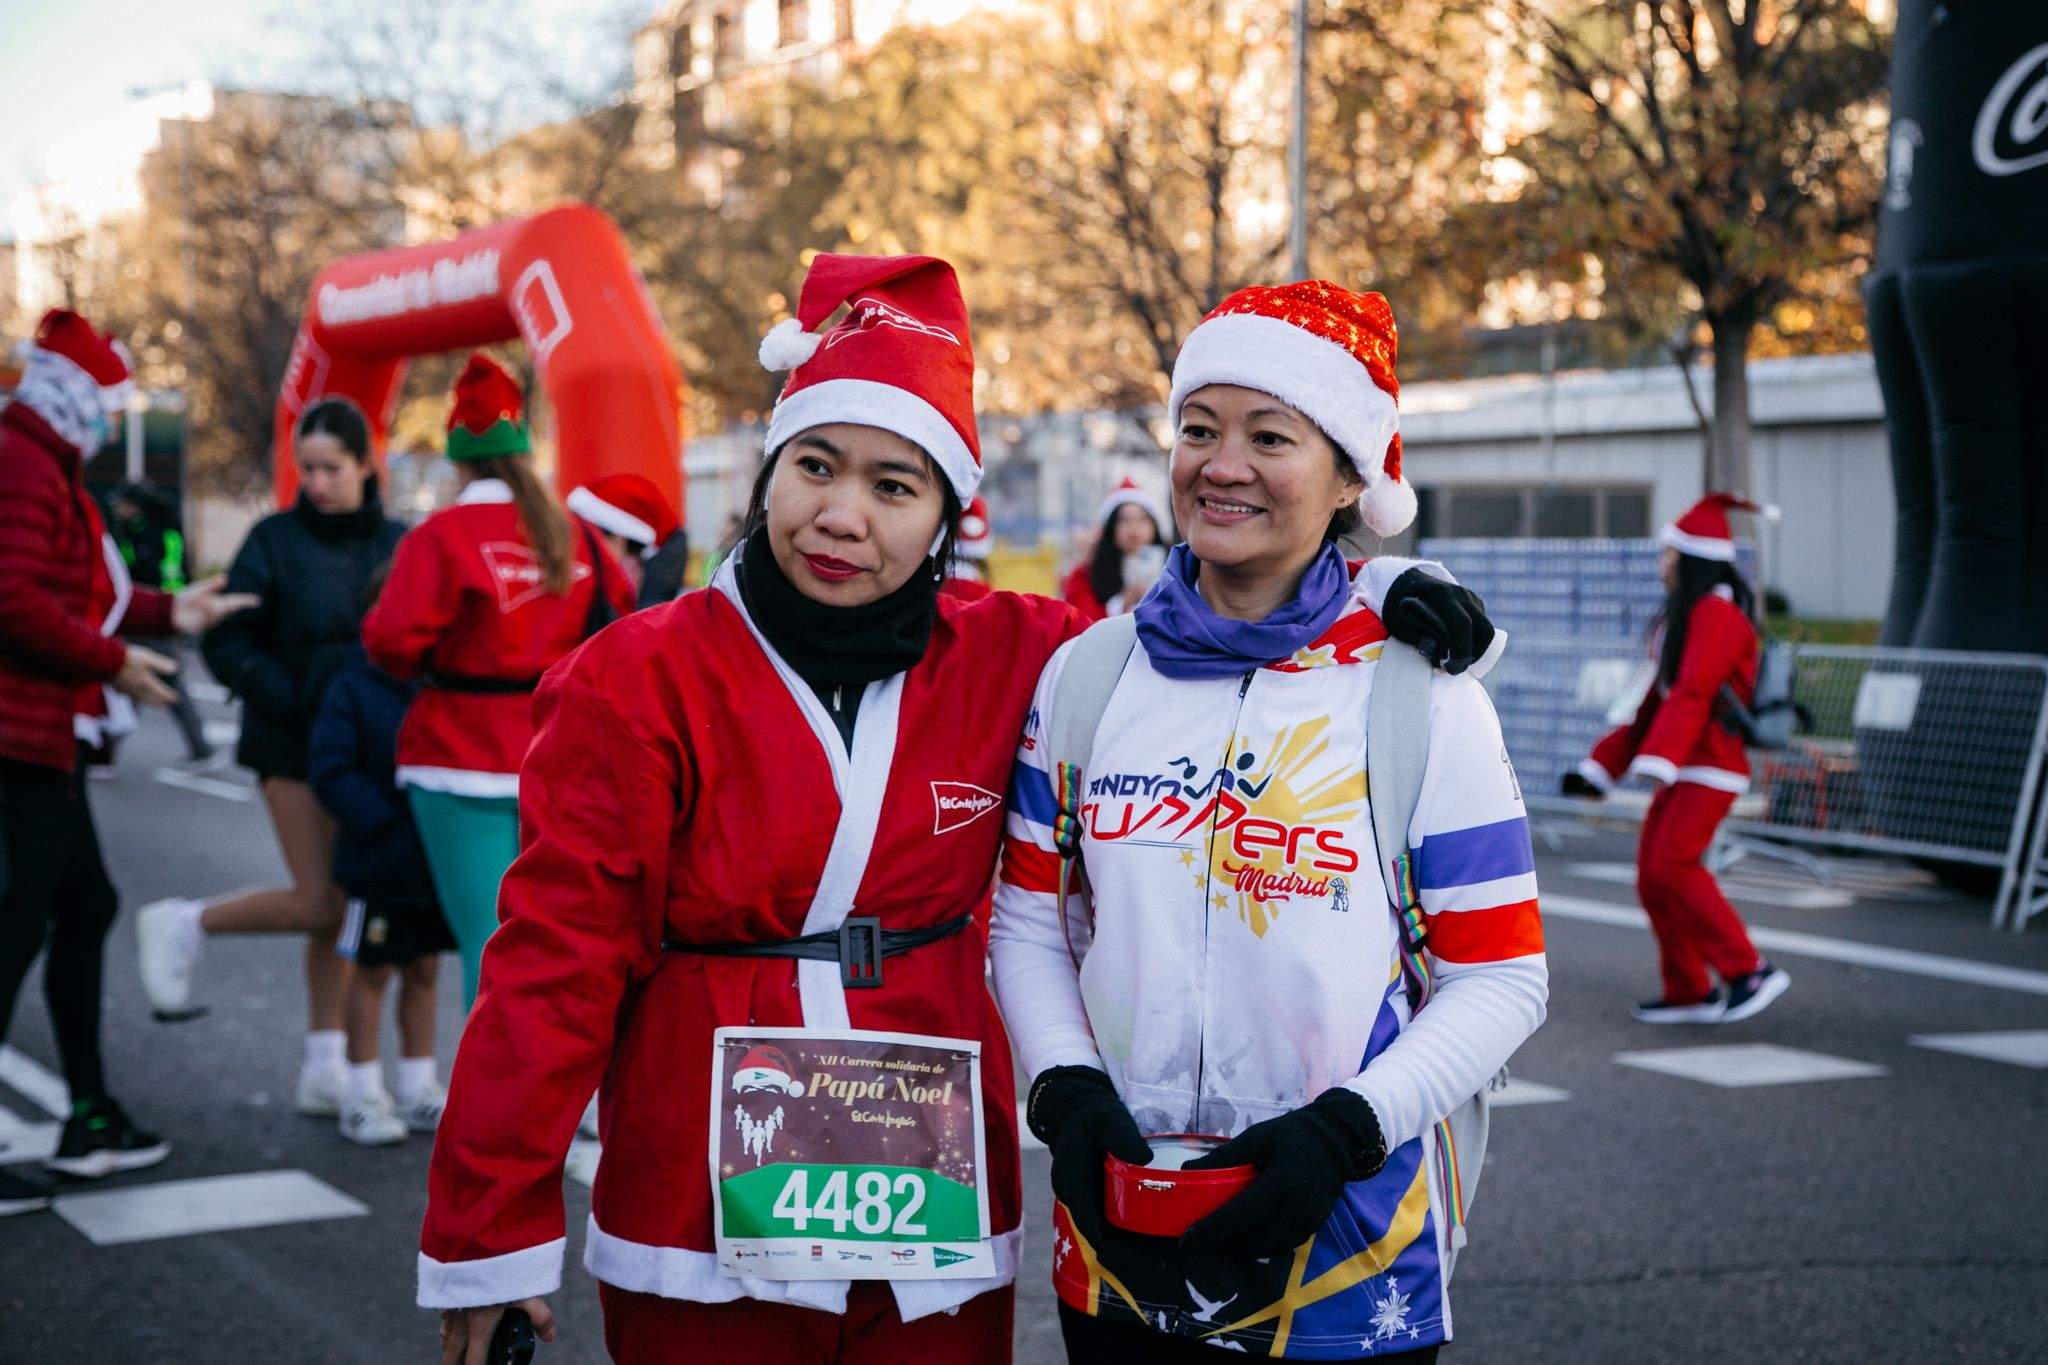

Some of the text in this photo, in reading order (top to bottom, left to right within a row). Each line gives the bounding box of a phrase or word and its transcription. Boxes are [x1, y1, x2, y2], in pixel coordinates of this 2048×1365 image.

[1223, 861, 1330, 902] Madrid
[819, 1055, 946, 1074] XII Carrera solidaria de
[807, 1072, 953, 1107] Papá Noel
[772, 1169, 928, 1236] 4482
